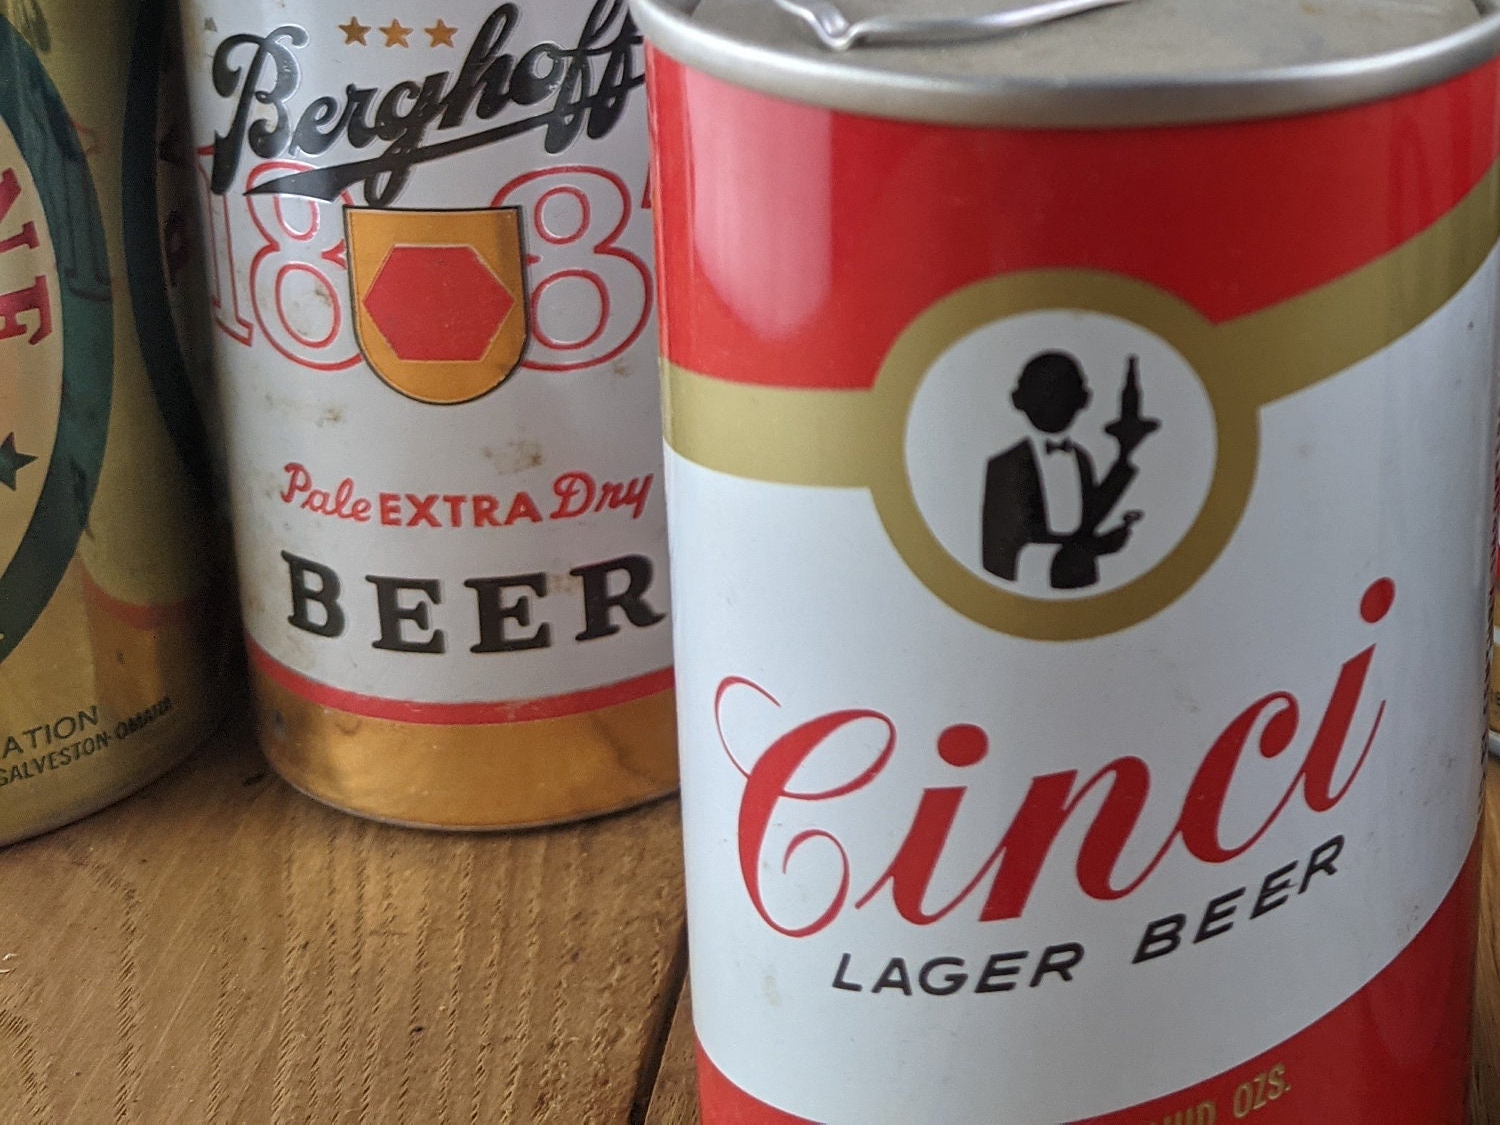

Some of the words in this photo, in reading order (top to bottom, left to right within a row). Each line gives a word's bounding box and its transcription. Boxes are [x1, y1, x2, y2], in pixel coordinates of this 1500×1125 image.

[280, 462, 372, 523] Pale
[380, 491, 543, 528] EXTRA
[549, 471, 656, 520] Dry
[281, 550, 667, 654] BEER
[2, 705, 99, 759] ATION
[714, 577, 1396, 938] Cinci
[832, 952, 1086, 998] LAGER
[1131, 834, 1345, 965] BEER
[1232, 1062, 1292, 1120] OZS.
